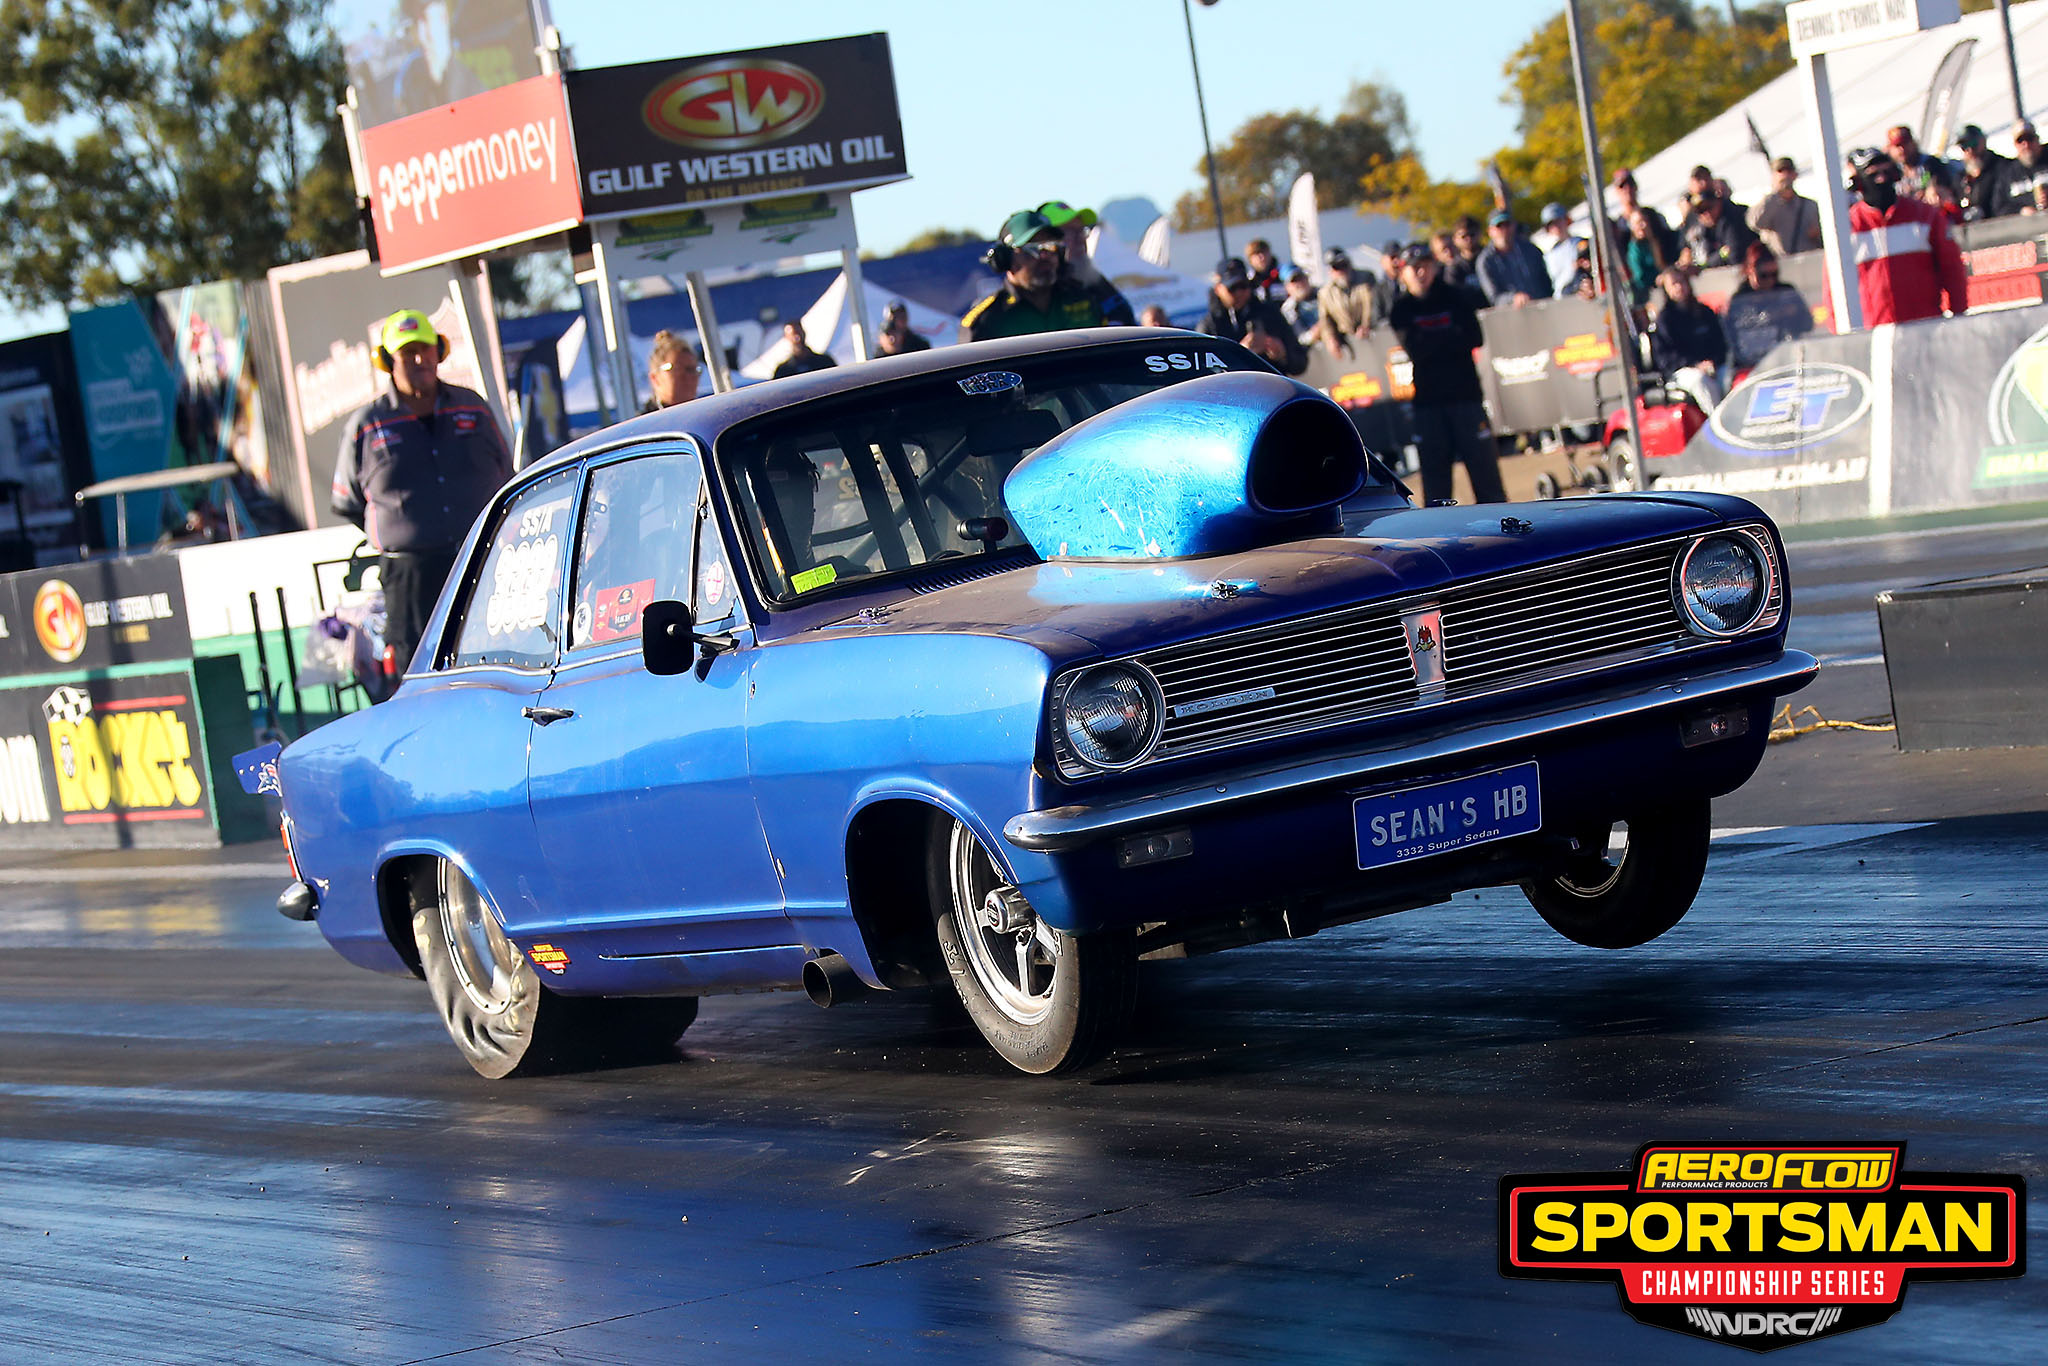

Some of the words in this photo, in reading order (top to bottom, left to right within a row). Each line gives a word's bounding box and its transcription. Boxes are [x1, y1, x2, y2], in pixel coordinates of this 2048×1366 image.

[661, 72, 805, 136] GW
[378, 117, 557, 233] peppermoney
[588, 161, 672, 195] GULF
[679, 142, 833, 184] WESTERN
[841, 135, 895, 164] OIL
[1144, 352, 1228, 373] SS/A
[519, 507, 553, 538] SS/A
[151, 592, 174, 618] OIL
[1370, 796, 1478, 847] SEAN'S
[1493, 784, 1528, 821] HB
[1396, 845, 1425, 858] 3332
[1427, 836, 1462, 853] Super
[1465, 828, 1501, 842] Sedan
